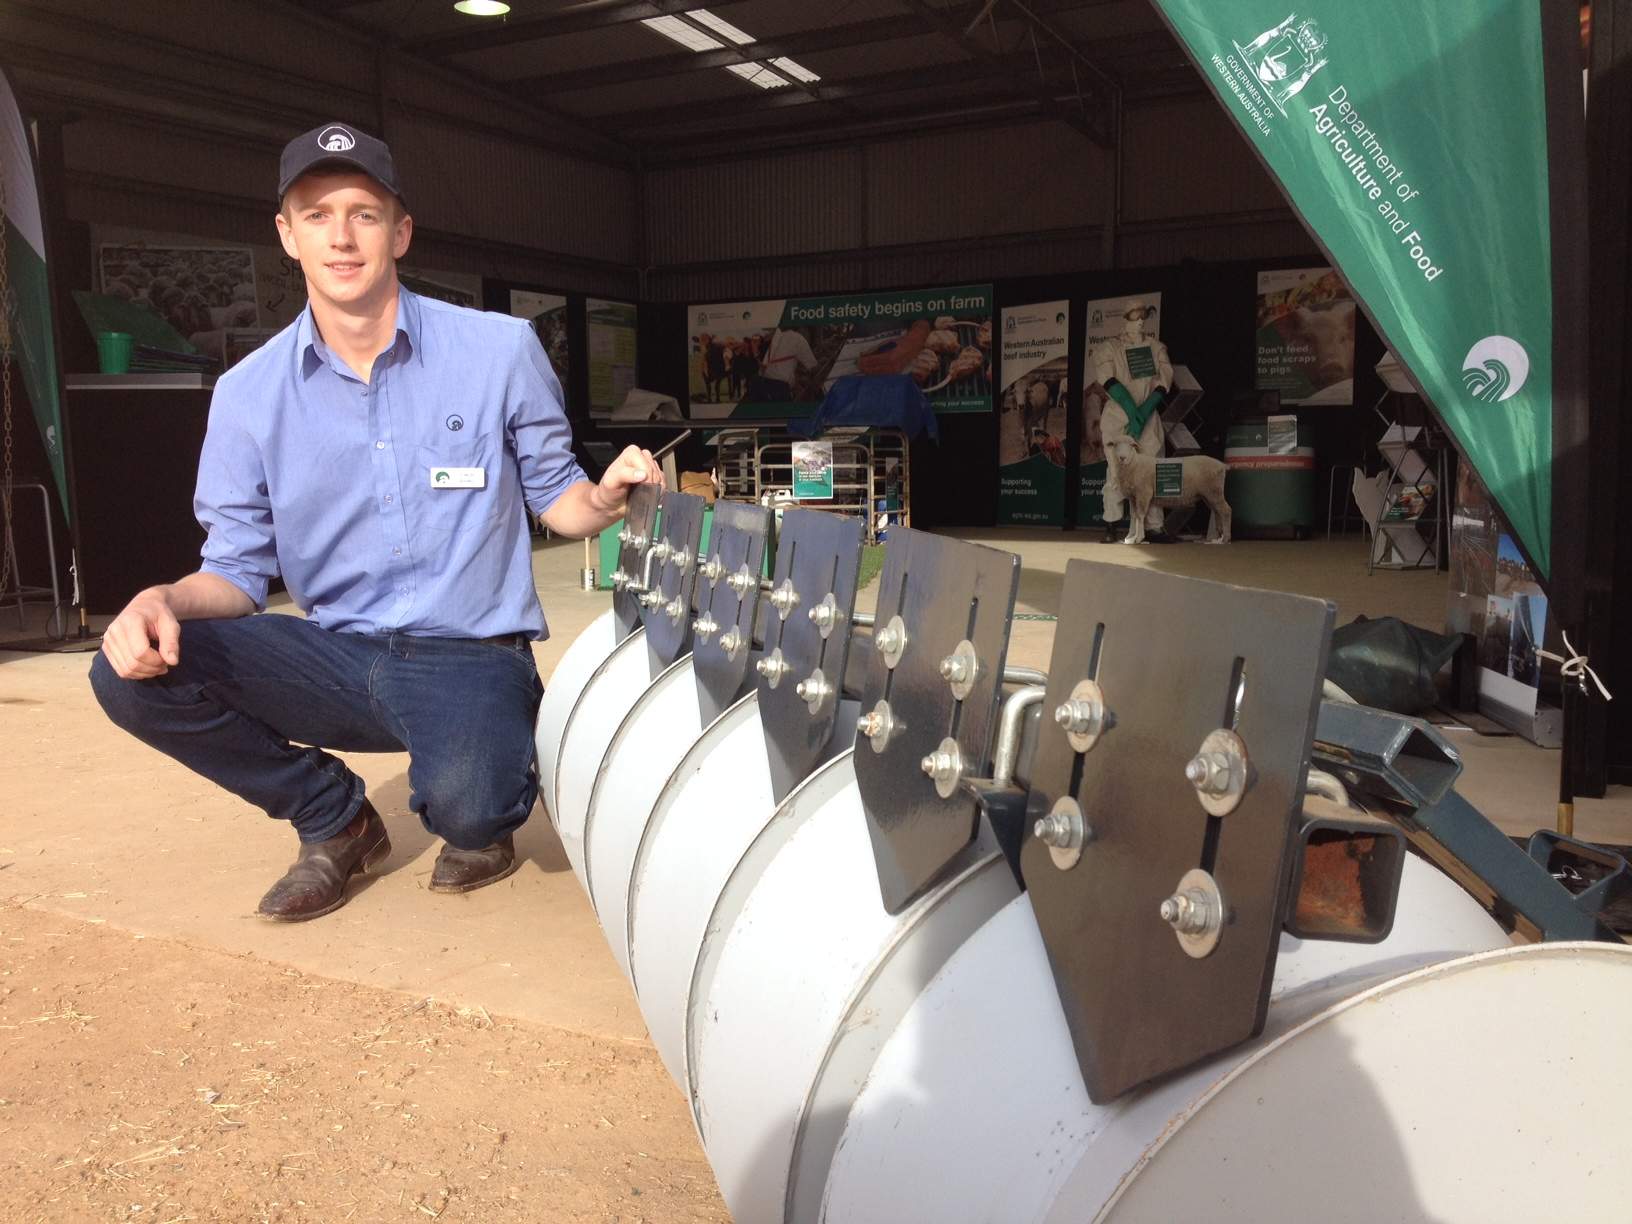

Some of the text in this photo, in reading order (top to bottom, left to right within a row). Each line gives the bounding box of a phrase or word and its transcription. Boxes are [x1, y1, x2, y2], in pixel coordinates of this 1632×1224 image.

[1226, 55, 1275, 119] GOVERNMENT OF
[1211, 54, 1271, 137] WESTERN AUSTRALIA
[1328, 85, 1419, 203] Department of
[1308, 103, 1443, 282] Agriculture and Food
[790, 296, 985, 321] Food safety begins on farm
[1004, 337, 1065, 350] Western Australian
[1258, 346, 1284, 354] Don't
[1003, 350, 1047, 360] beef industry
[1257, 356, 1280, 364] food
[1001, 478, 1032, 487] Supporting
[1014, 488, 1038, 496] success
